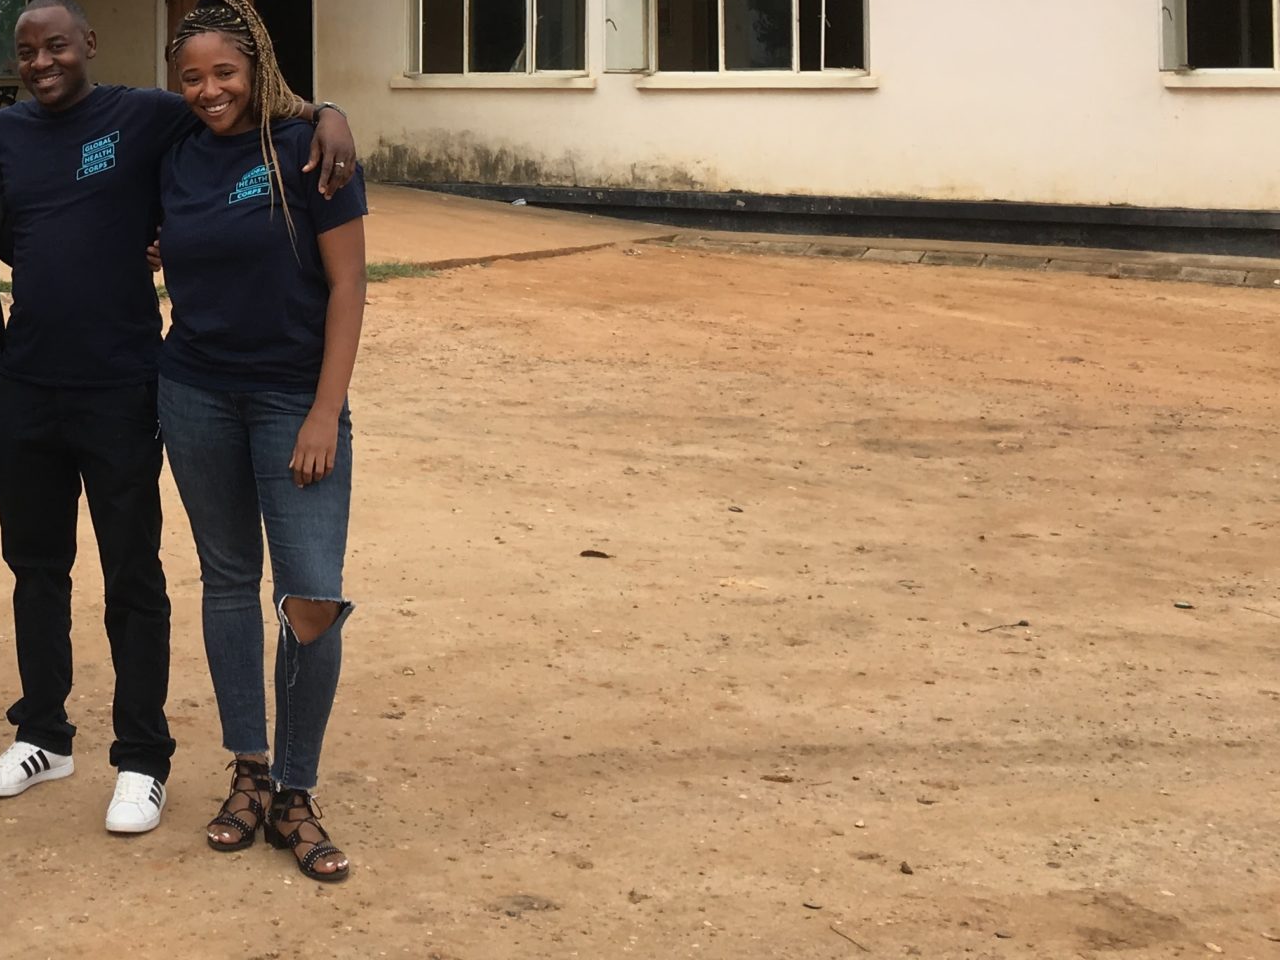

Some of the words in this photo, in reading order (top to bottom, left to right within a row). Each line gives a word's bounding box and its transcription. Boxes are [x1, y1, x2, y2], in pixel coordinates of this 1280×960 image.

[84, 137, 112, 152] GLOBAL
[84, 148, 112, 163] HEALTH
[83, 162, 108, 174] CORPS
[239, 176, 267, 188] HEALTH
[237, 188, 262, 199] CORPS
